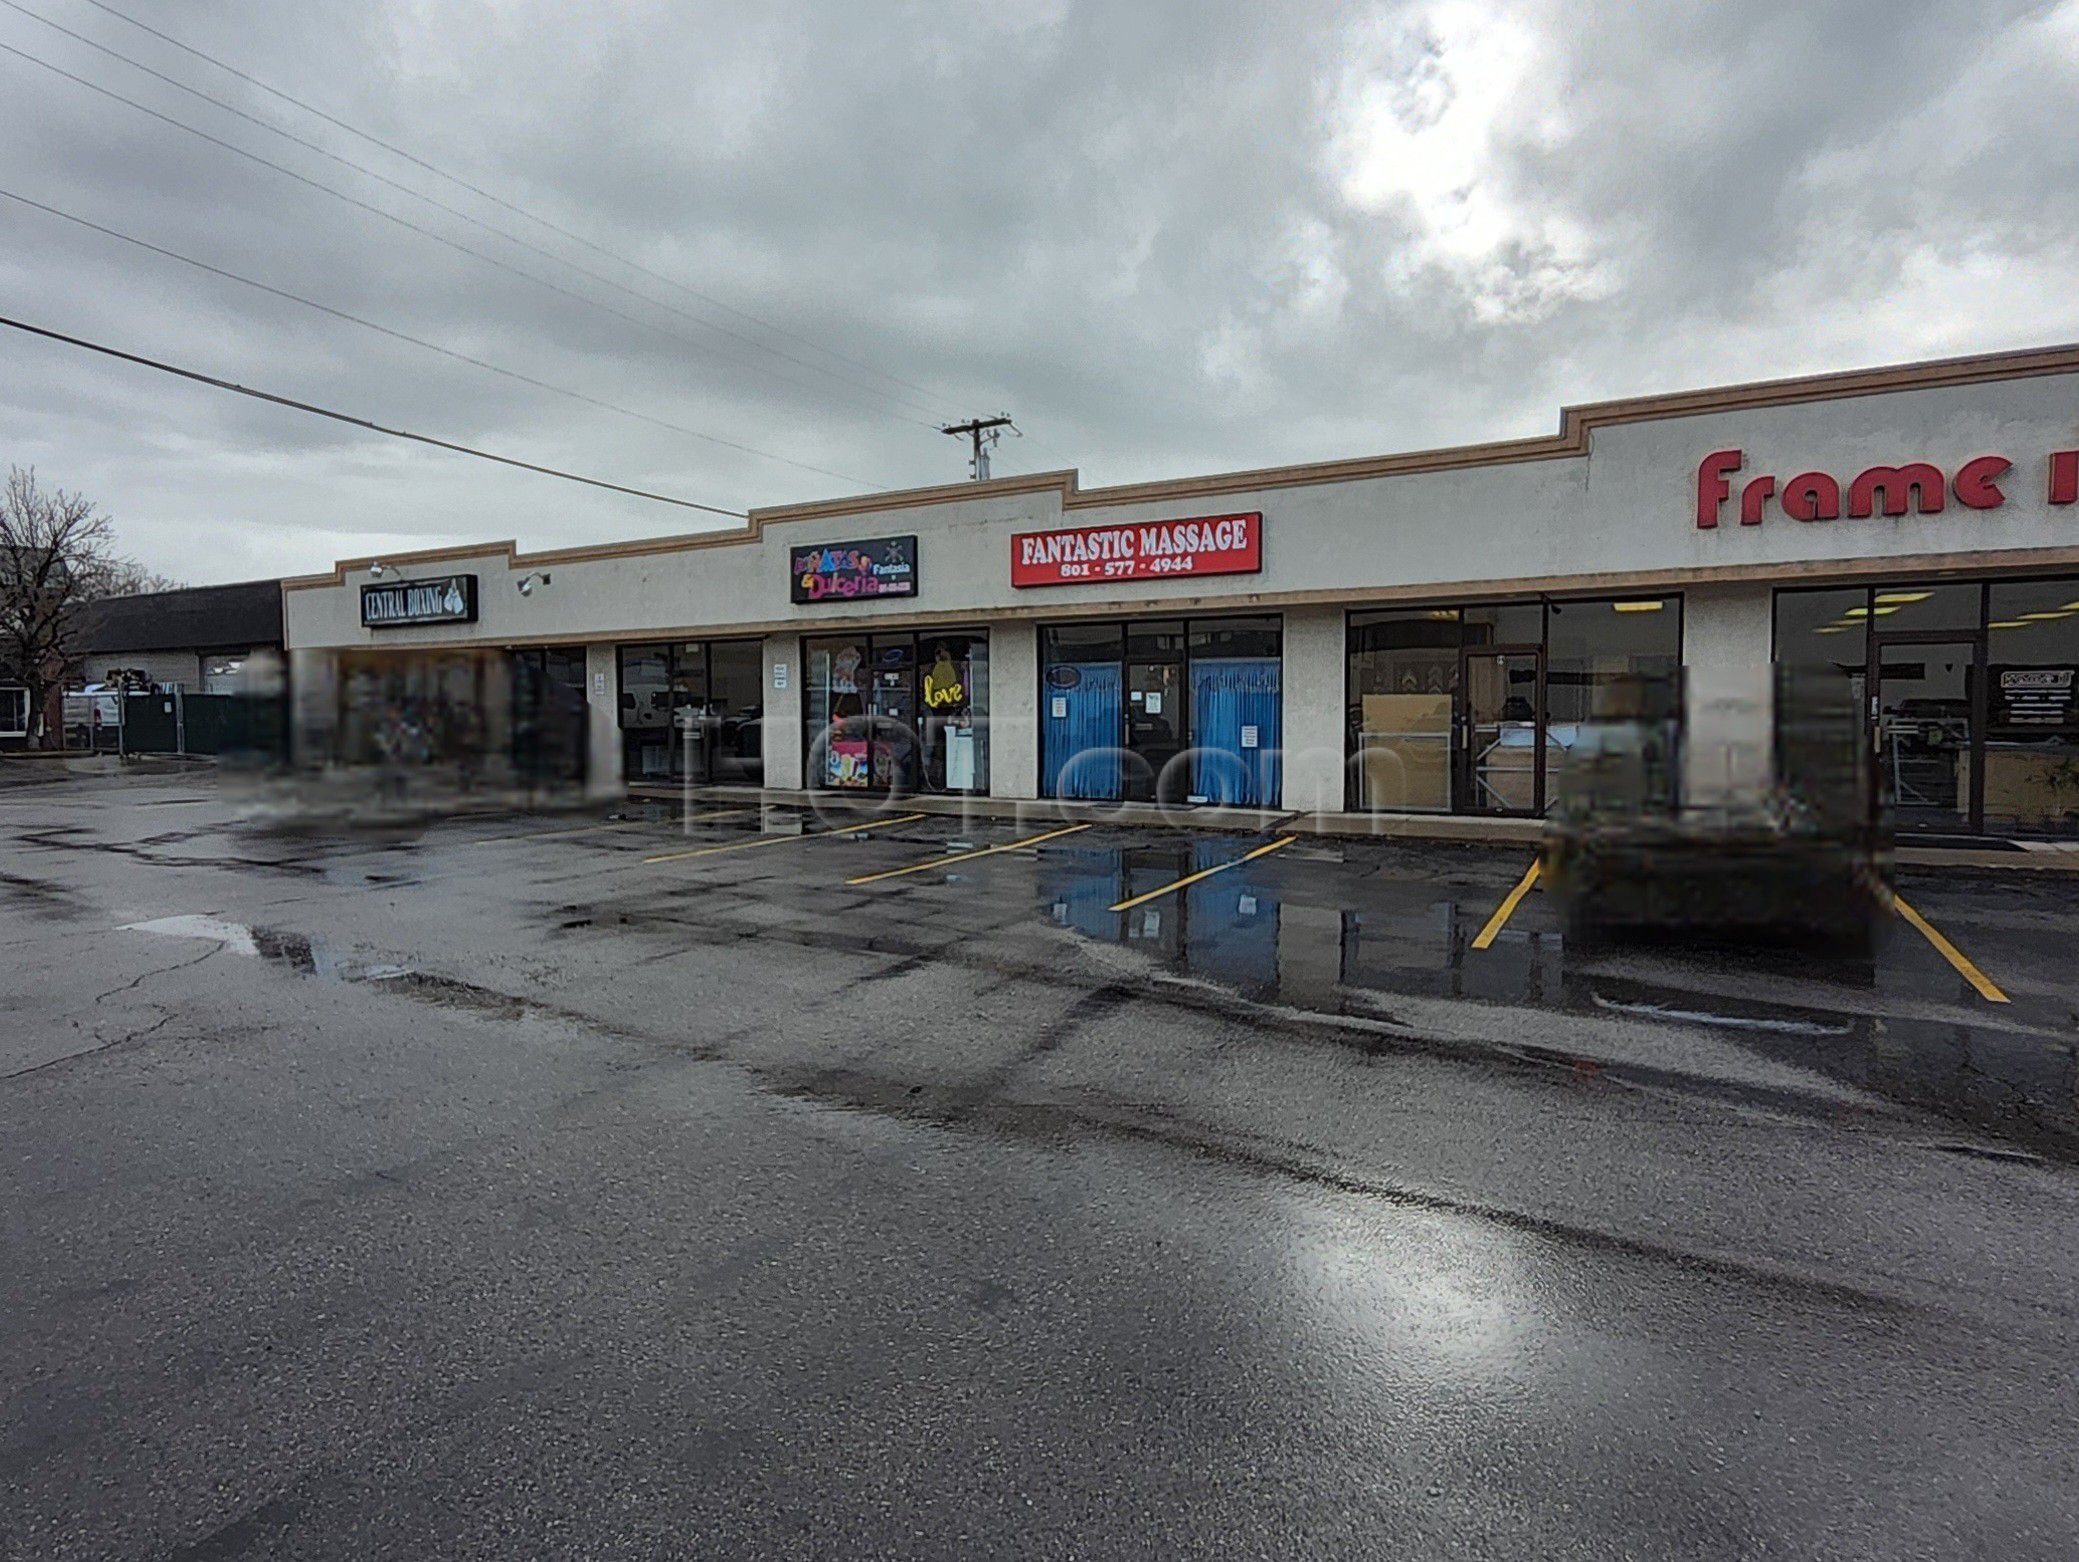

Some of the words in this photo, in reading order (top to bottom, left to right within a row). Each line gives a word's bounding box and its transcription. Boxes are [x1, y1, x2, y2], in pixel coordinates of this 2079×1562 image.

[1022, 530, 1135, 565] FANTASTIC
[1140, 519, 1248, 557] MASSAGE
[365, 591, 406, 620] CENTRAL
[407, 586, 443, 617] BOXING
